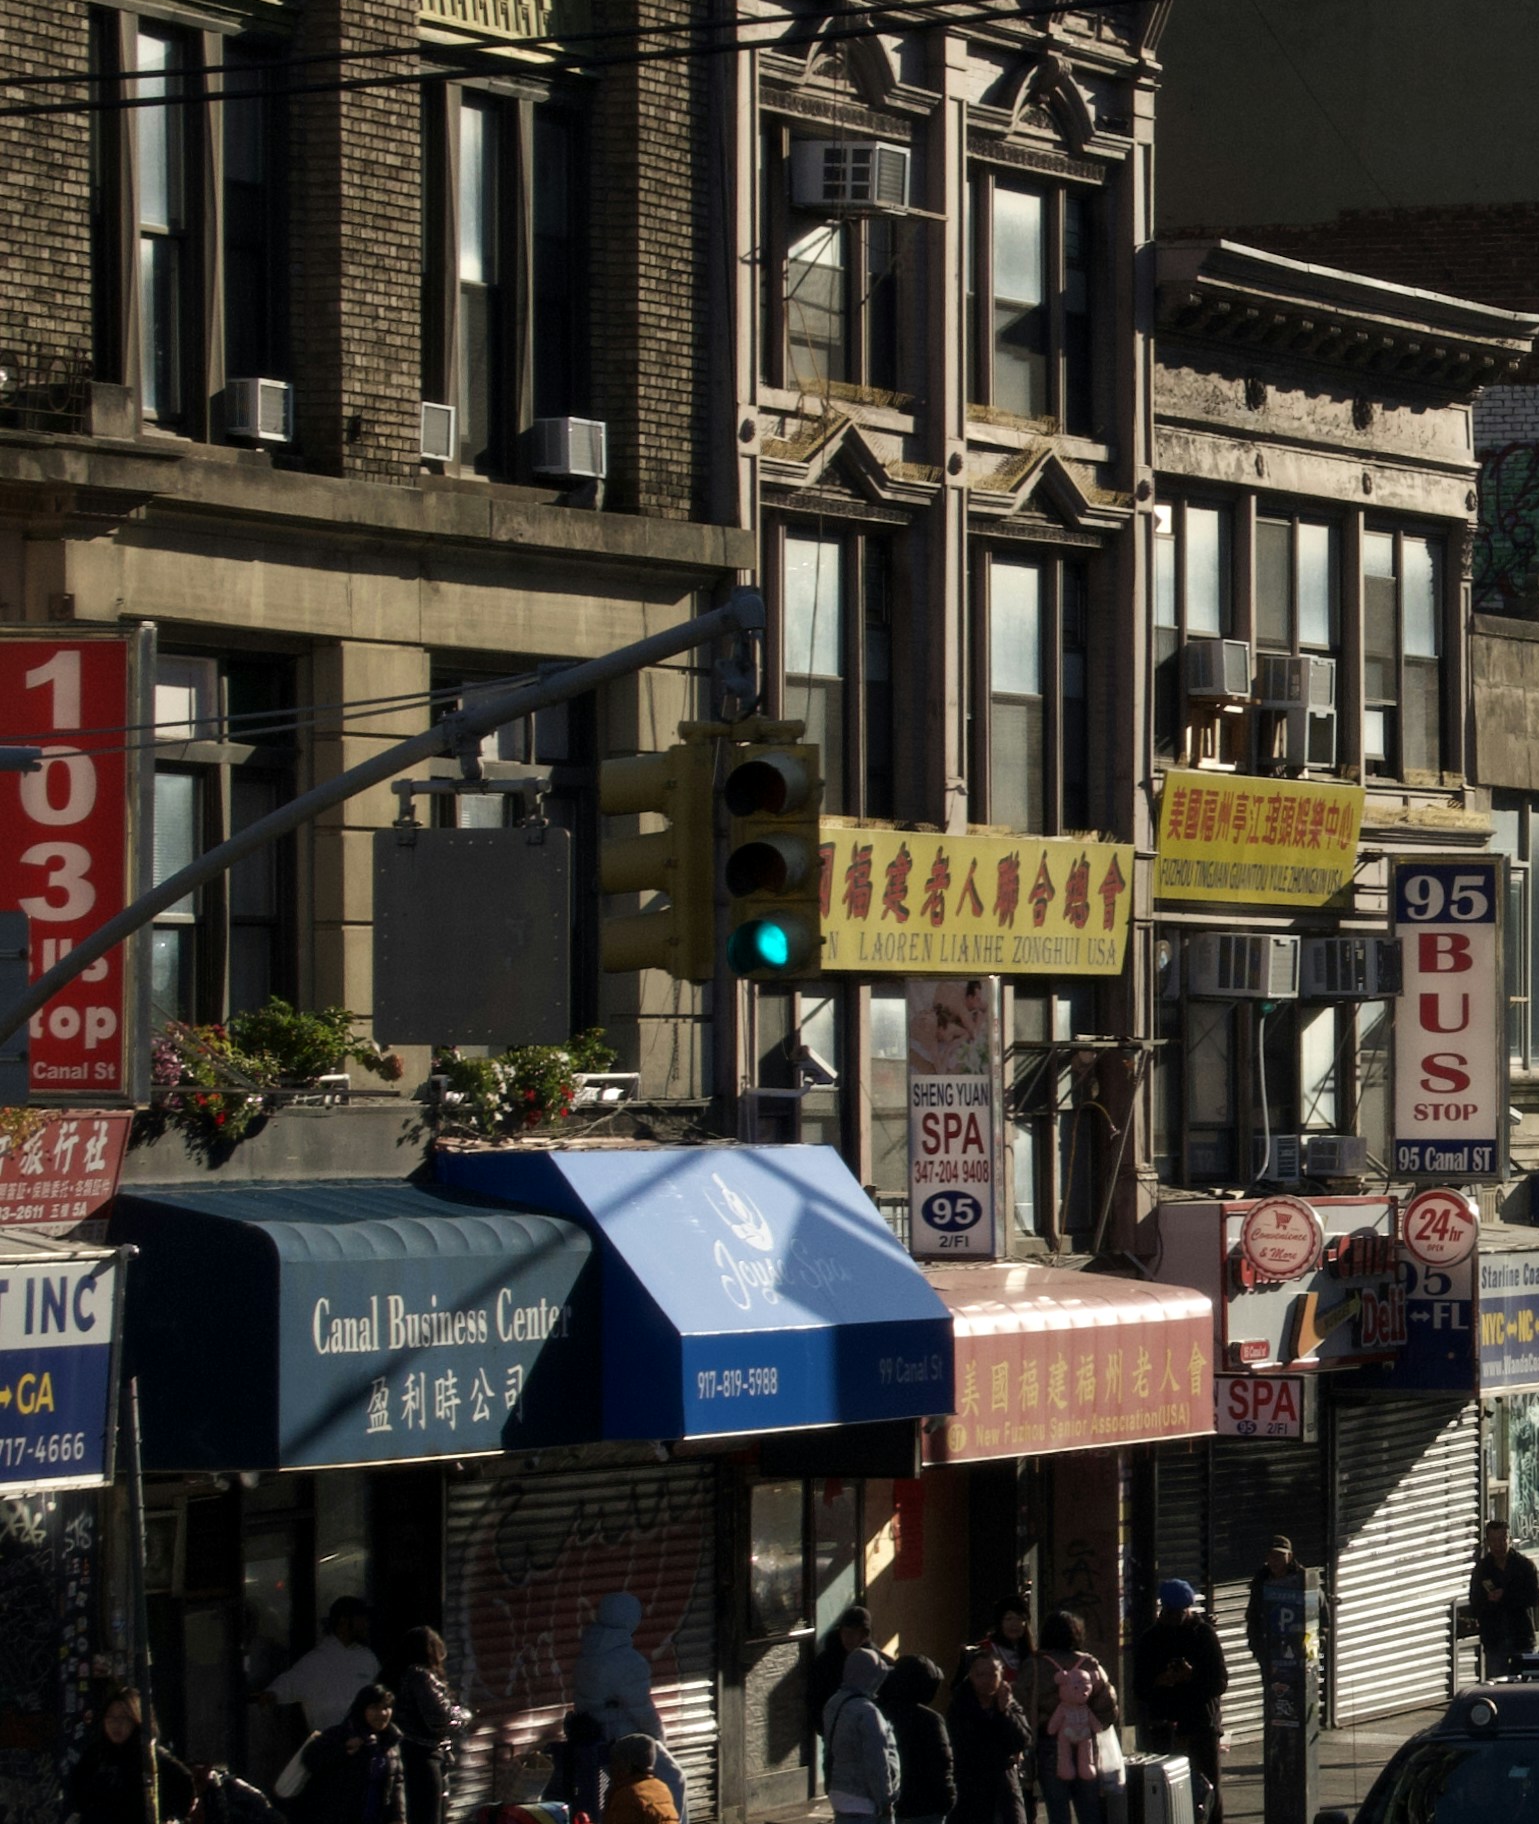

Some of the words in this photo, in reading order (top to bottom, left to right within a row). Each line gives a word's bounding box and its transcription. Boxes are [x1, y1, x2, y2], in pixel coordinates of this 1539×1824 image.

[1404, 875, 1488, 921] 95
[859, 931, 933, 963] LAOREN
[941, 933, 1004, 965] LIANHE
[1012, 936, 1080, 967] ZONGHUI
[1088, 939, 1117, 967] USA
[1419, 933, 1473, 1094] BUS
[33, 1061, 89, 1081] Canal
[94, 1061, 115, 1081] St
[913, 1082, 954, 1107] SHENG
[956, 1082, 988, 1106] YUAN
[1413, 1103, 1477, 1121] STOP
[922, 1112, 984, 1155] SPA
[915, 1160, 958, 1184] 347-204
[963, 1159, 989, 1183] 9408
[1399, 1146, 1422, 1172] 95
[1425, 1146, 1469, 1172] Canal
[1474, 1146, 1493, 1171] ST
[73, 1201, 87, 1217] 5A
[932, 1198, 974, 1225] 95
[1251, 1228, 1306, 1242] Convenience
[1259, 1247, 1267, 1257] &
[1269, 1247, 1297, 1260] More
[1482, 1265, 1519, 1289] Starline
[25, 1276, 97, 1335] INC
[312, 1295, 379, 1354] Canal
[388, 1292, 487, 1350] Business
[496, 1286, 571, 1343] Center
[1361, 1282, 1407, 1347] Deli
[1433, 1302, 1469, 1329] FL
[1482, 1312, 1505, 1346] NYC
[1518, 1309, 1533, 1342] NC
[697, 1367, 778, 1399] 917-819-5988
[879, 1357, 892, 1384] 99
[896, 1355, 928, 1383] Canal
[931, 1354, 942, 1381] St
[961, 1341, 1207, 1417] 美國福建福州老人會
[17, 1372, 55, 1415] GA
[1229, 1380, 1296, 1422] SPA
[976, 1425, 1000, 1447] New
[1005, 1422, 1044, 1444] Fuzhou
[1050, 1417, 1087, 1440] Senior
[1240, 1421, 1255, 1434] 95
[1280, 1607, 1294, 1633] P
